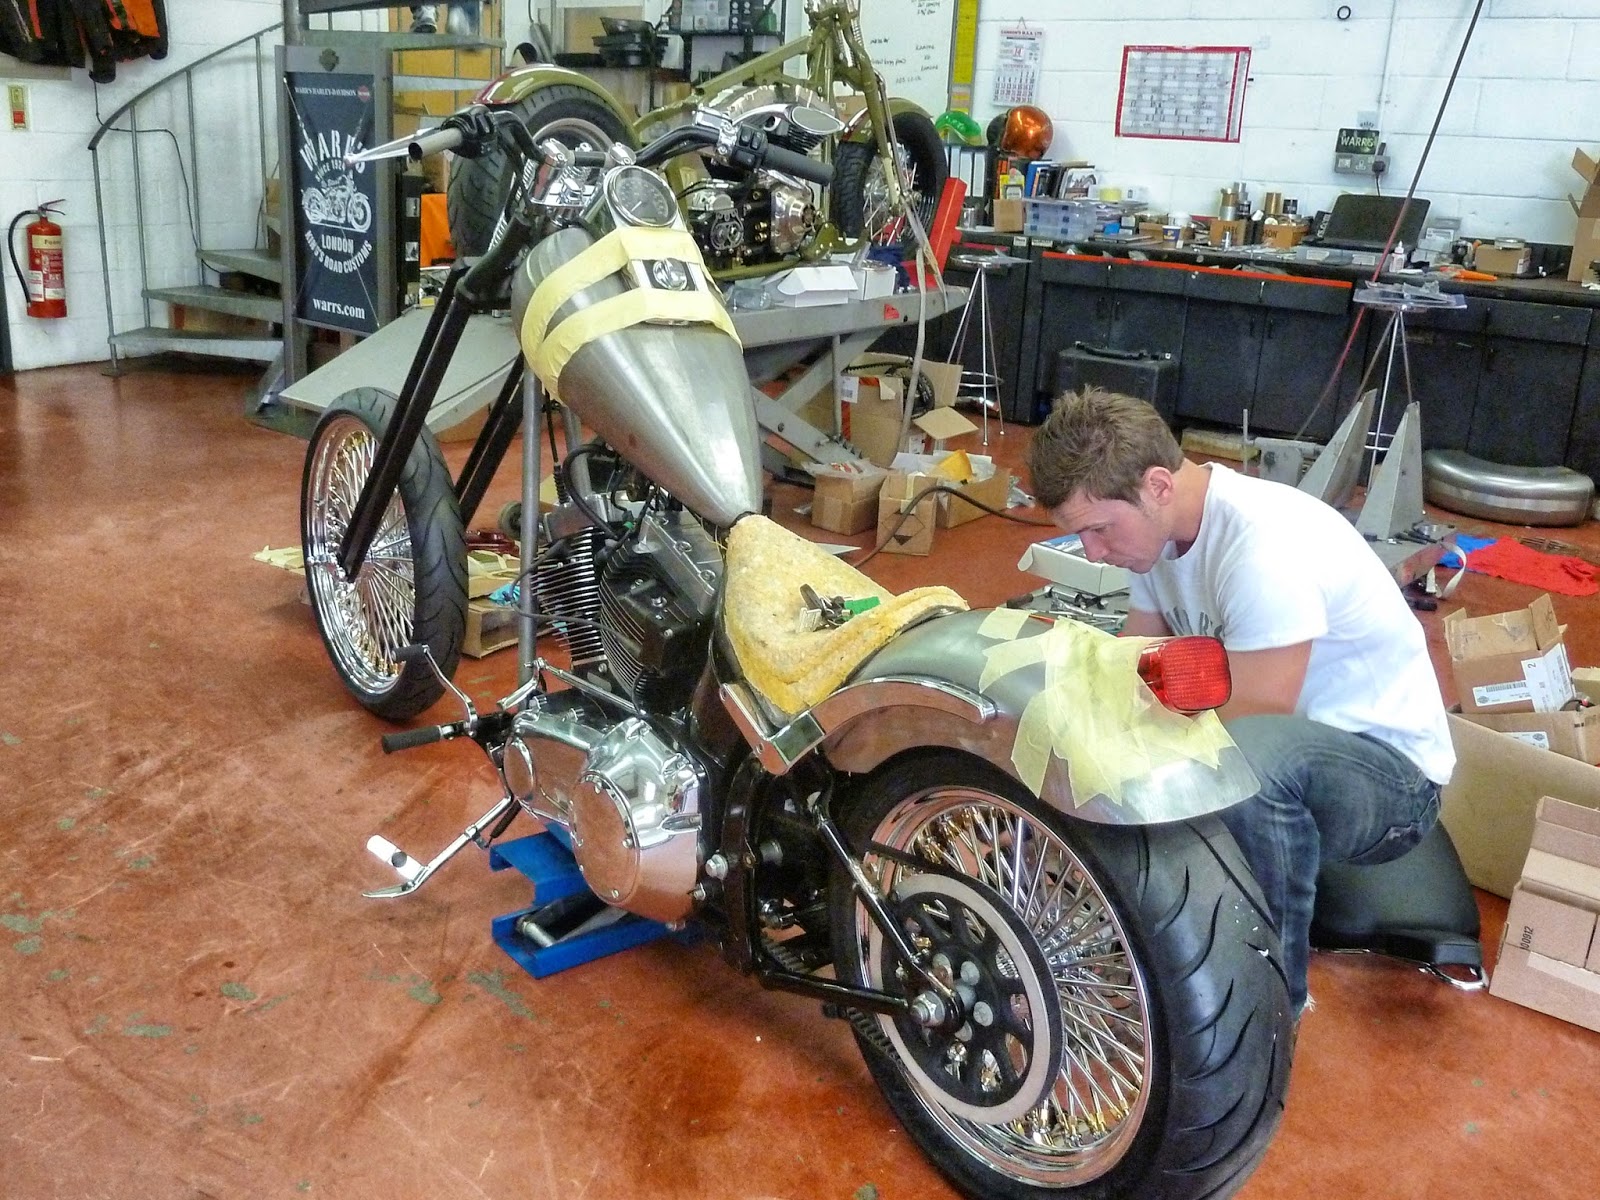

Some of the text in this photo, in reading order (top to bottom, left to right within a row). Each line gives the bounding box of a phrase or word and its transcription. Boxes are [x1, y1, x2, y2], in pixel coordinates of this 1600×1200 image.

[321, 234, 354, 254] LONDON
[323, 254, 343, 274] ROAD
[343, 240, 373, 274] CUSTOMS
[312, 298, 366, 320] warrs.com
